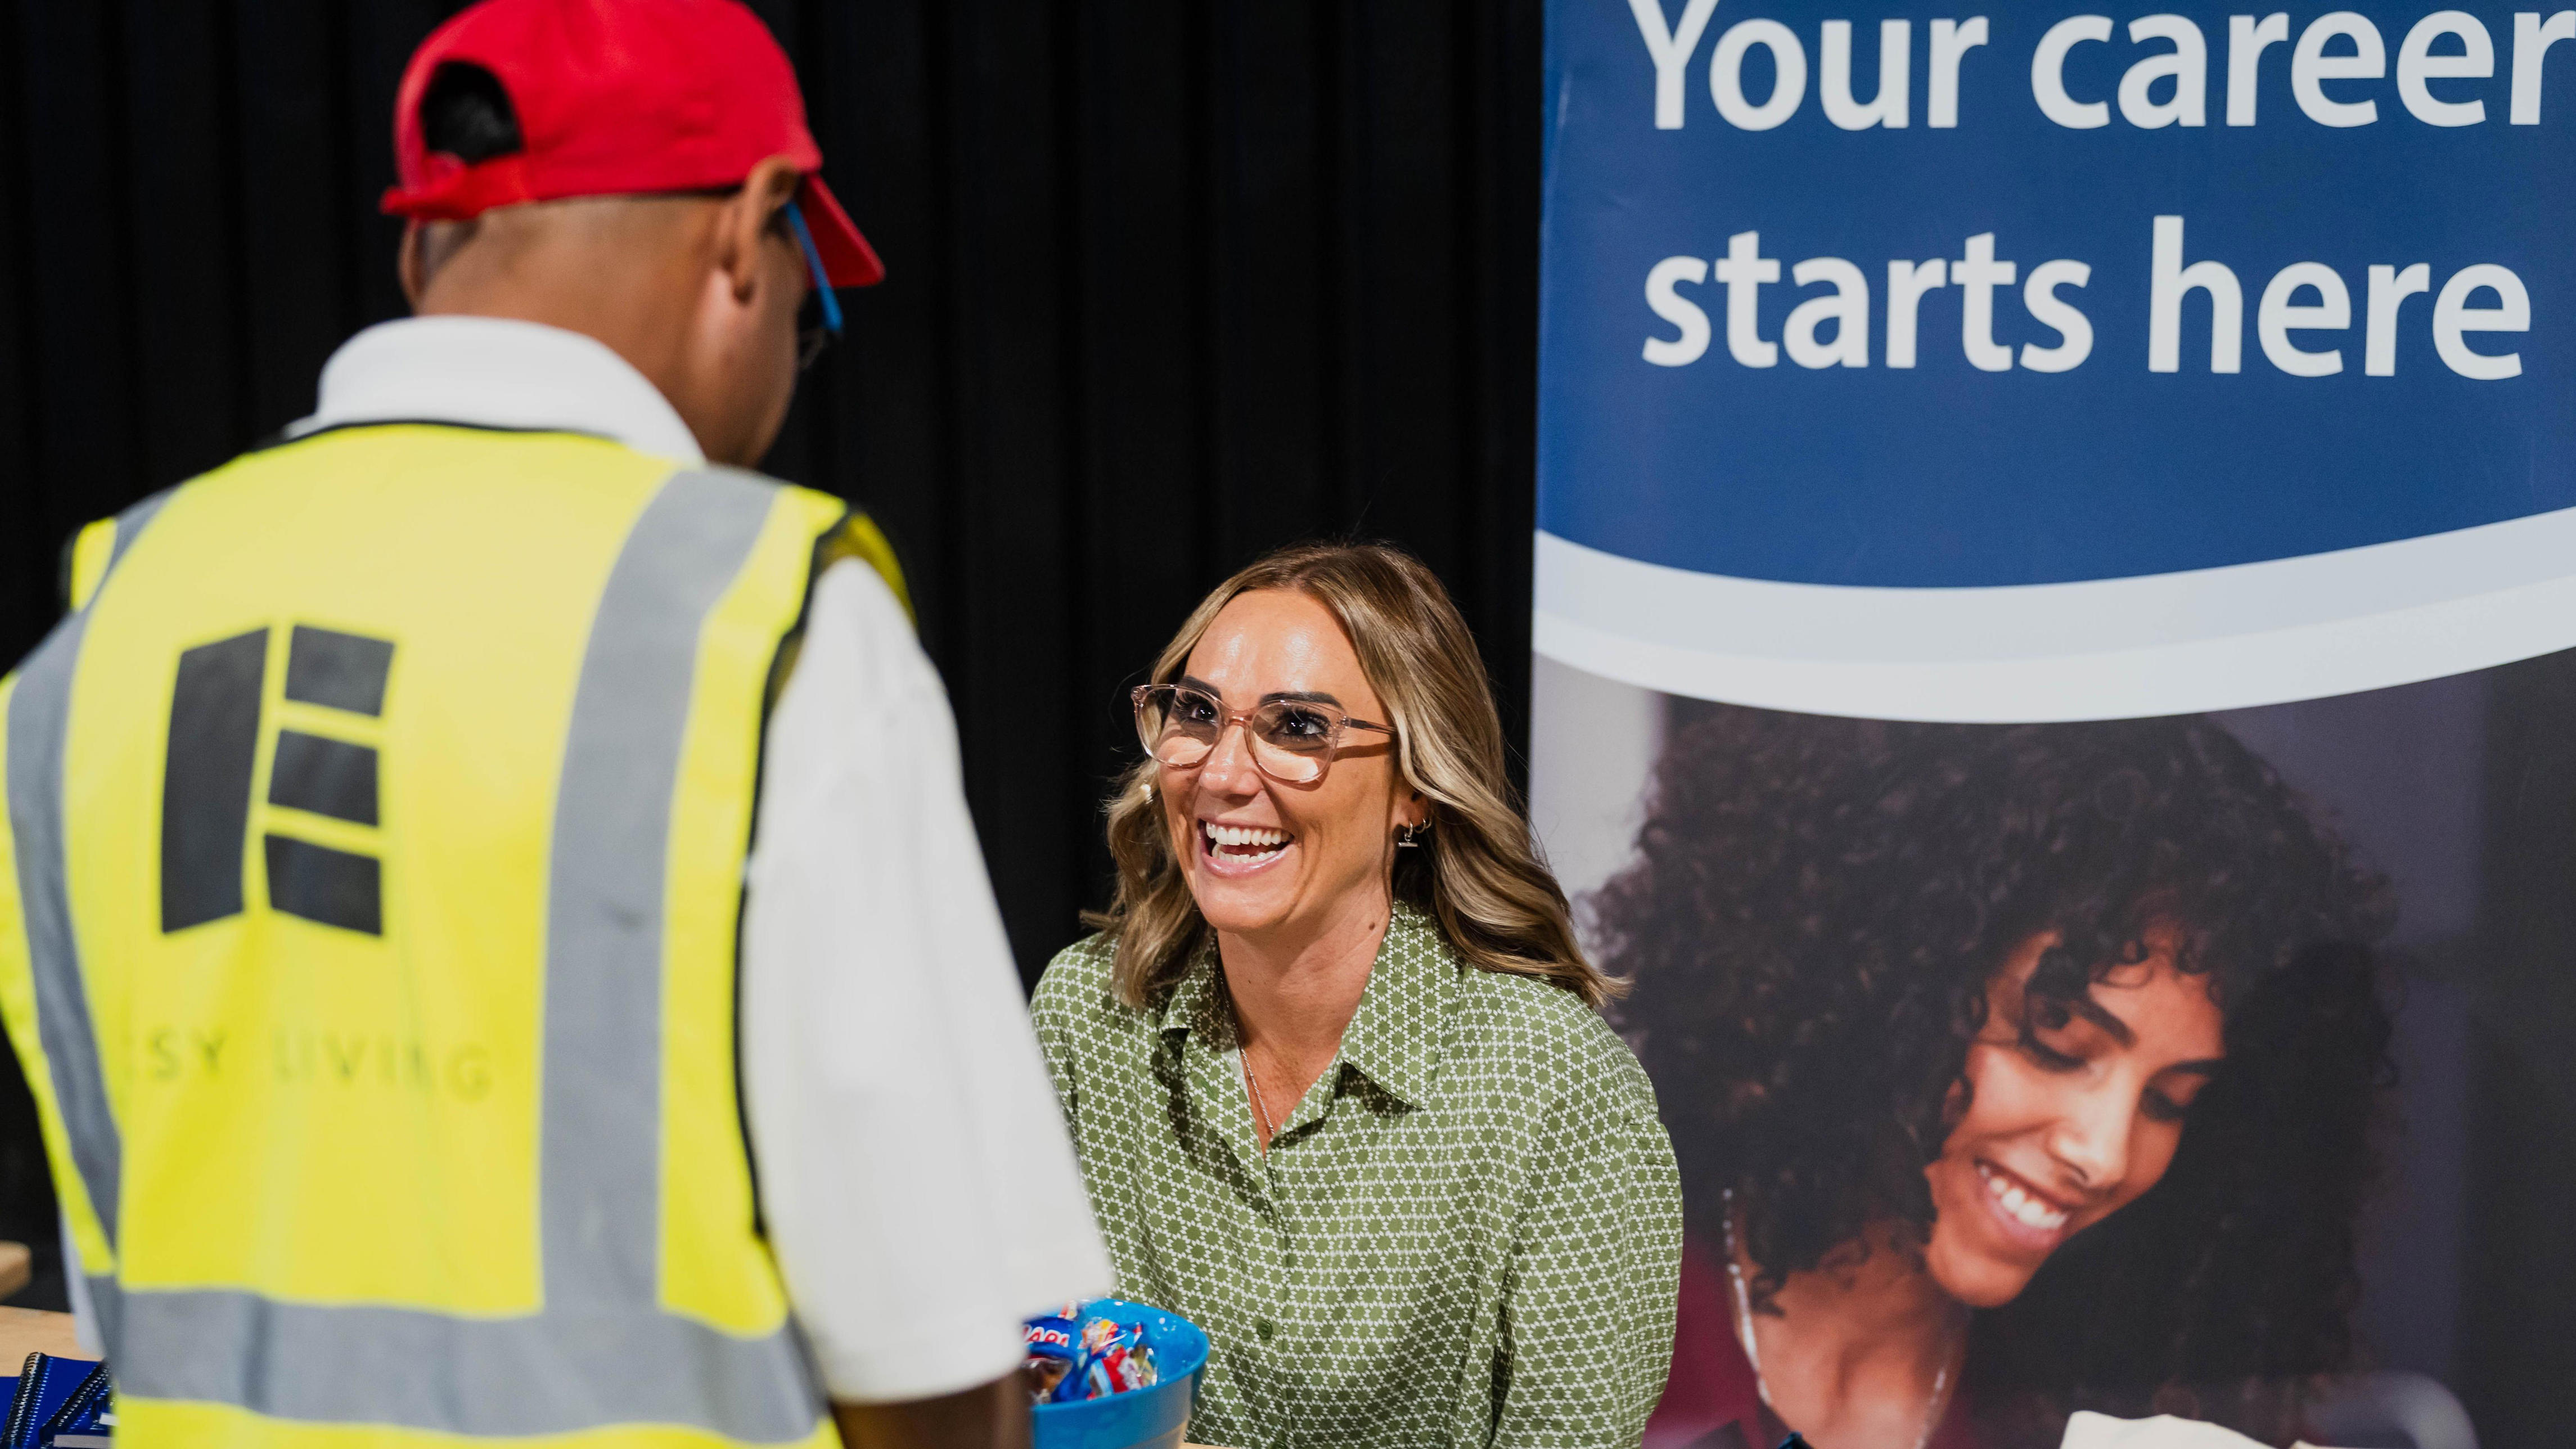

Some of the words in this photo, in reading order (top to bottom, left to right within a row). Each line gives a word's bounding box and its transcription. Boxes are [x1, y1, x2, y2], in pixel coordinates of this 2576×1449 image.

[1628, 0, 1989, 130] Your
[2031, 10, 2576, 129] career
[1642, 231, 2094, 373] starts
[2148, 215, 2531, 380] here
